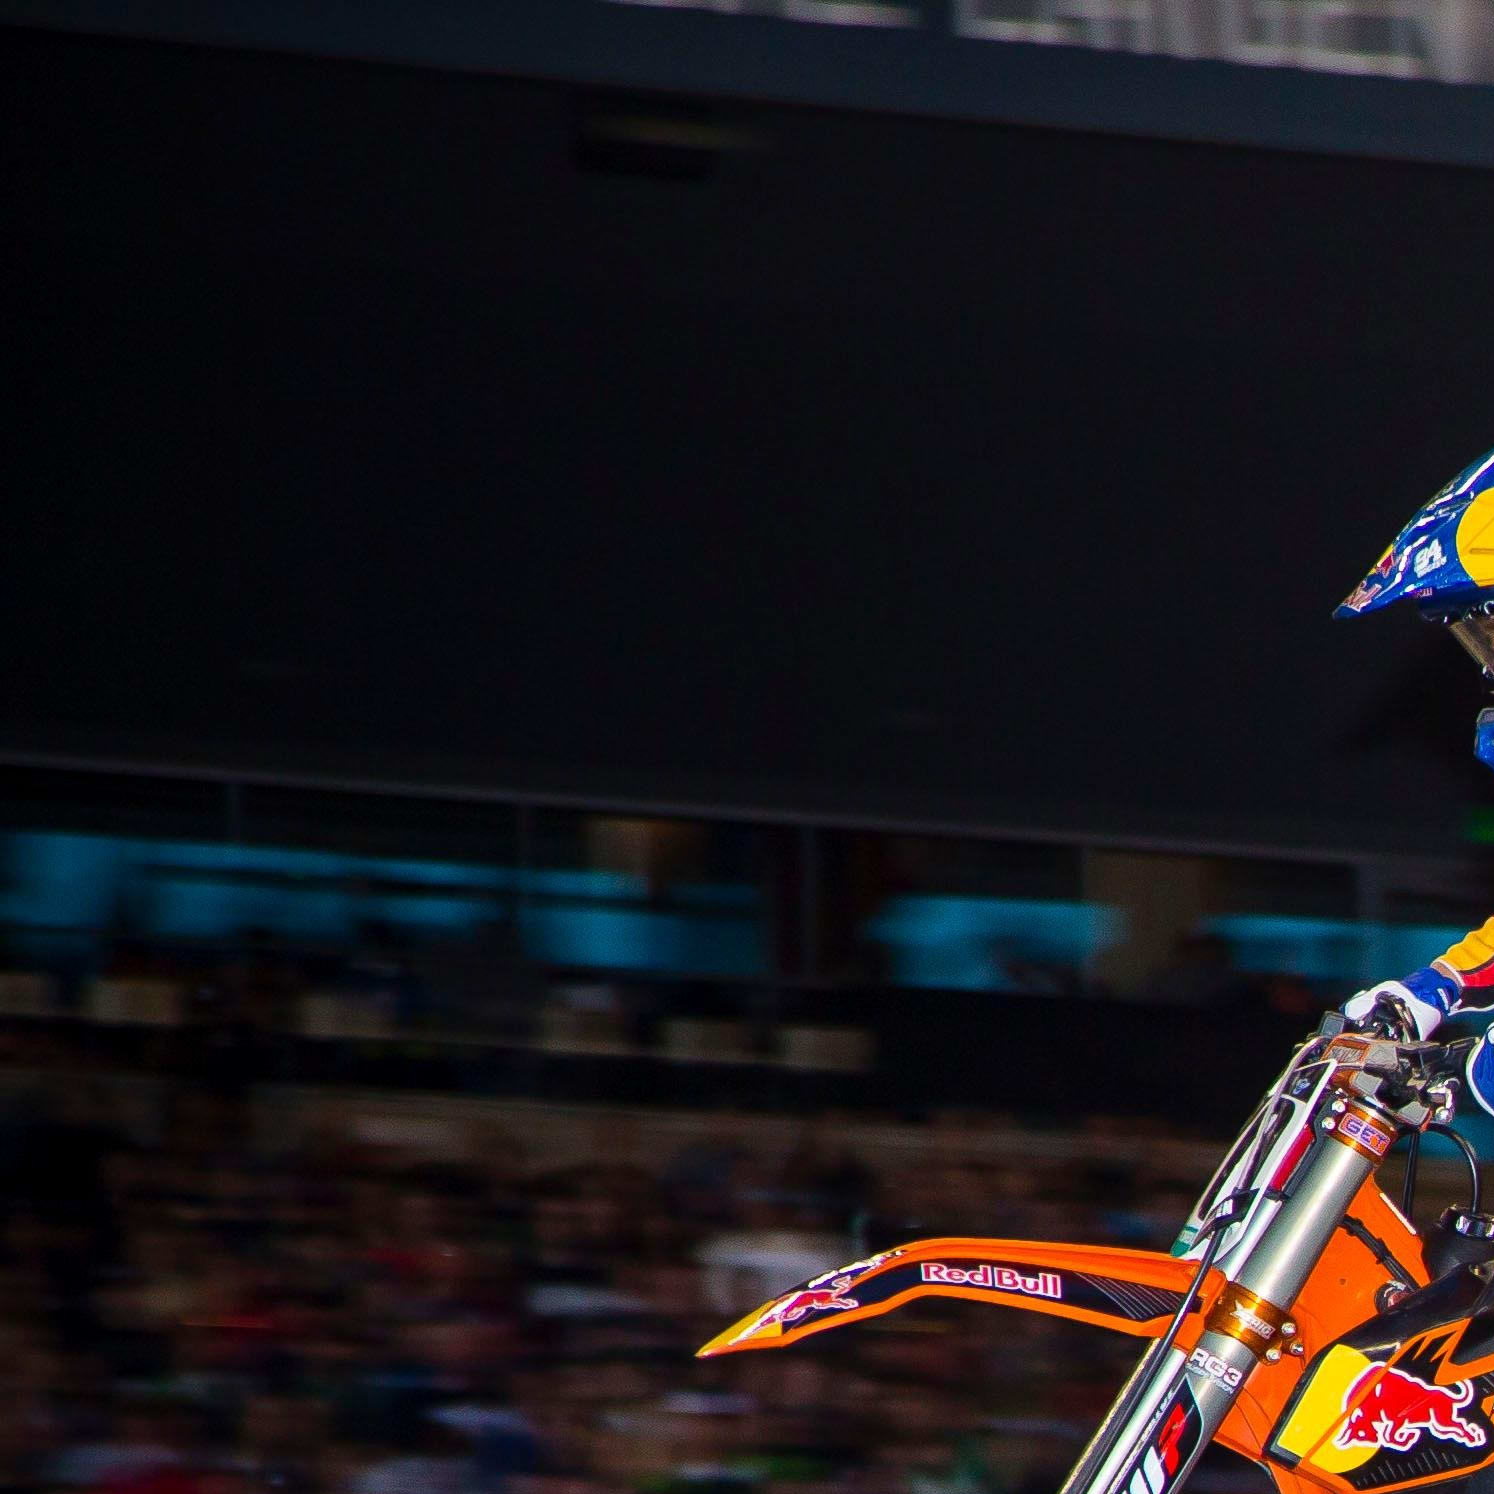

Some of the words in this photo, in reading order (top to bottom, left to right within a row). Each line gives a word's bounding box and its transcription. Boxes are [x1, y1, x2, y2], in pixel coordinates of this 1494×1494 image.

[921, 1262, 993, 1287] Red
[994, 1267, 1062, 1298] Bull
[1188, 1347, 1244, 1387] RG3
